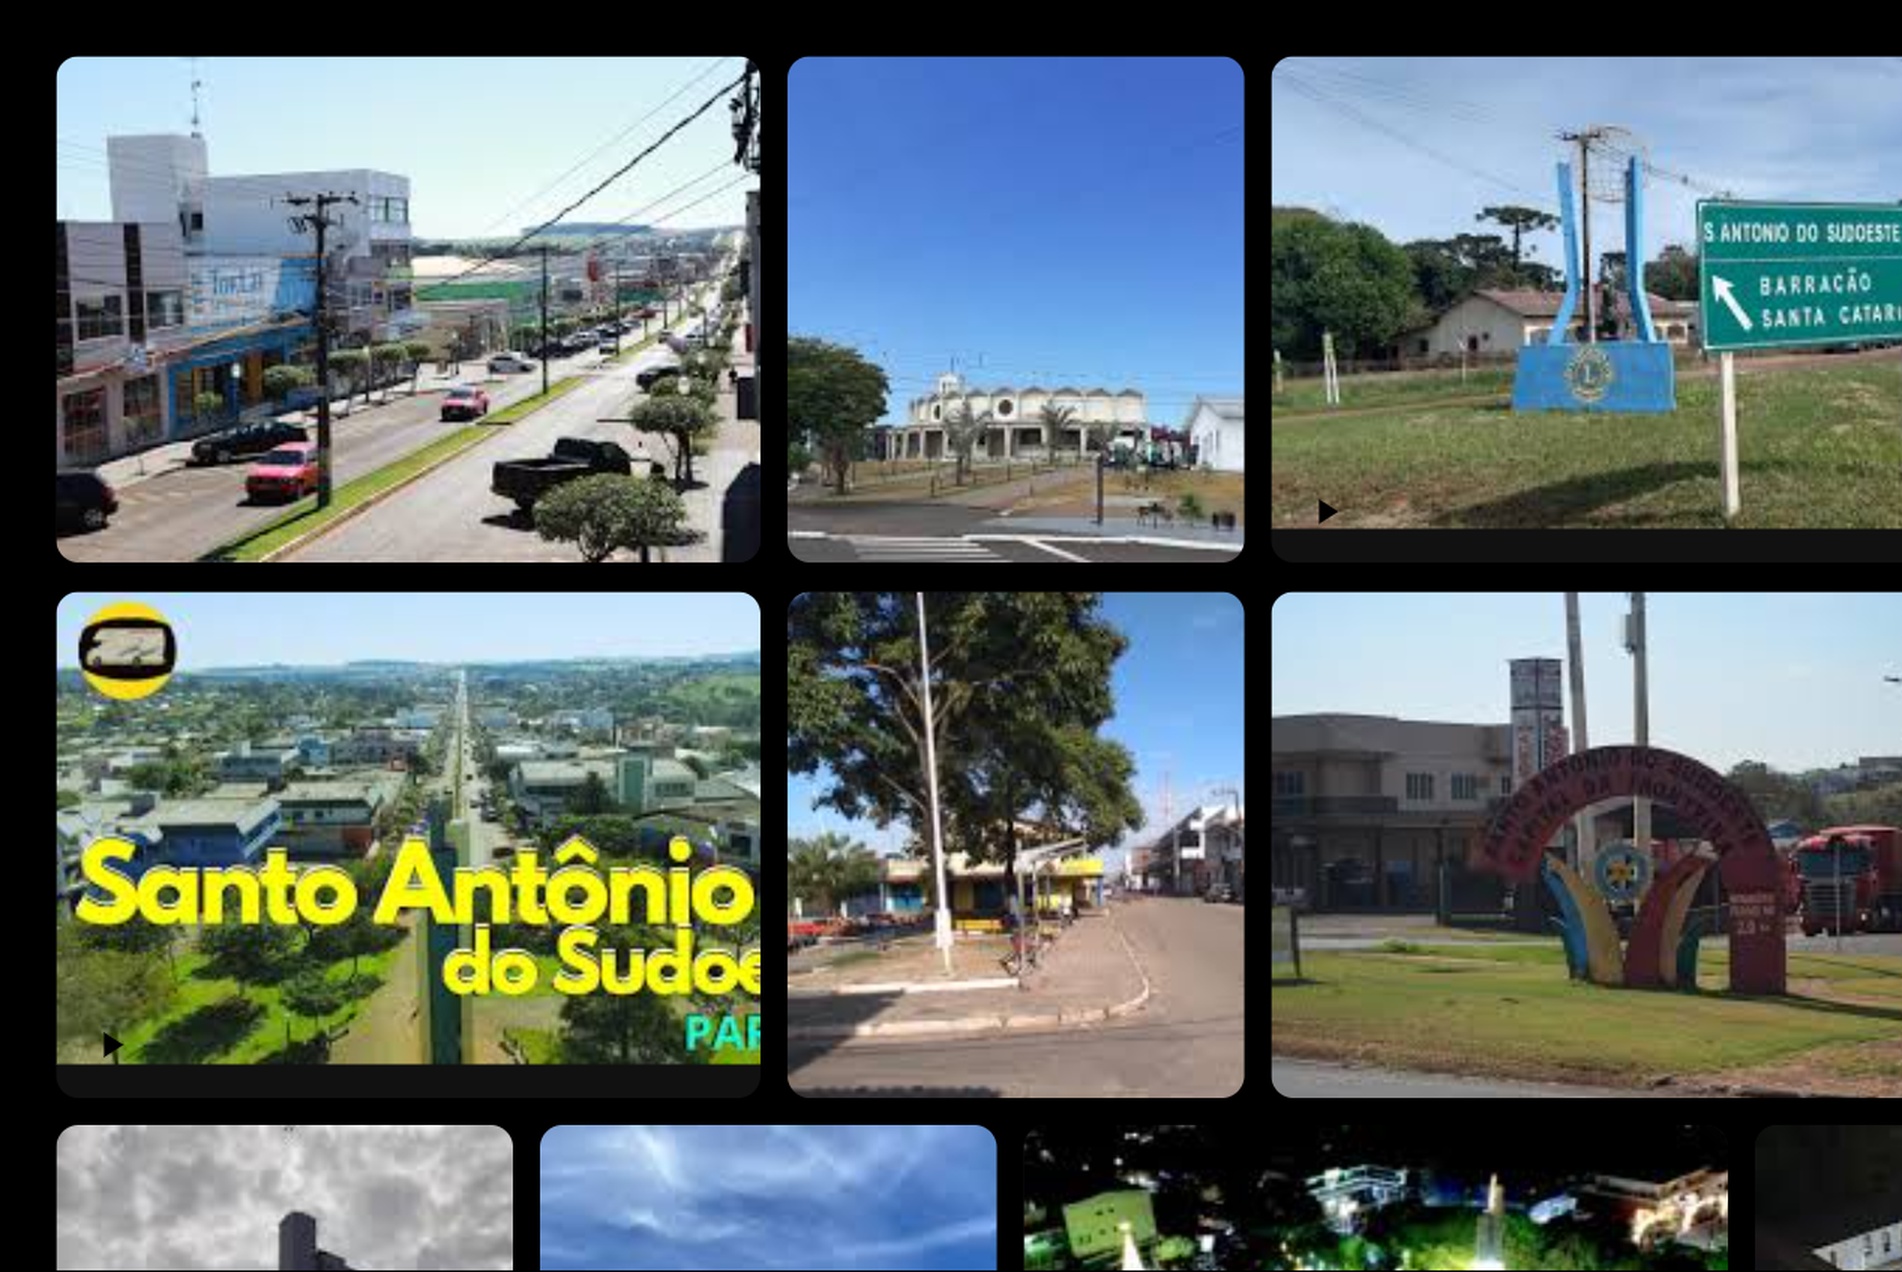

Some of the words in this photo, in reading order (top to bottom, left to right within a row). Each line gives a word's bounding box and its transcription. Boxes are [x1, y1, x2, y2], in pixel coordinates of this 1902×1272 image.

[1703, 222, 1714, 242] S
[1720, 222, 1790, 242] ANTONIO
[1796, 223, 1818, 242] DO
[1827, 222, 1901, 243] SUDOESTE
[1762, 306, 1826, 327] SANTA
